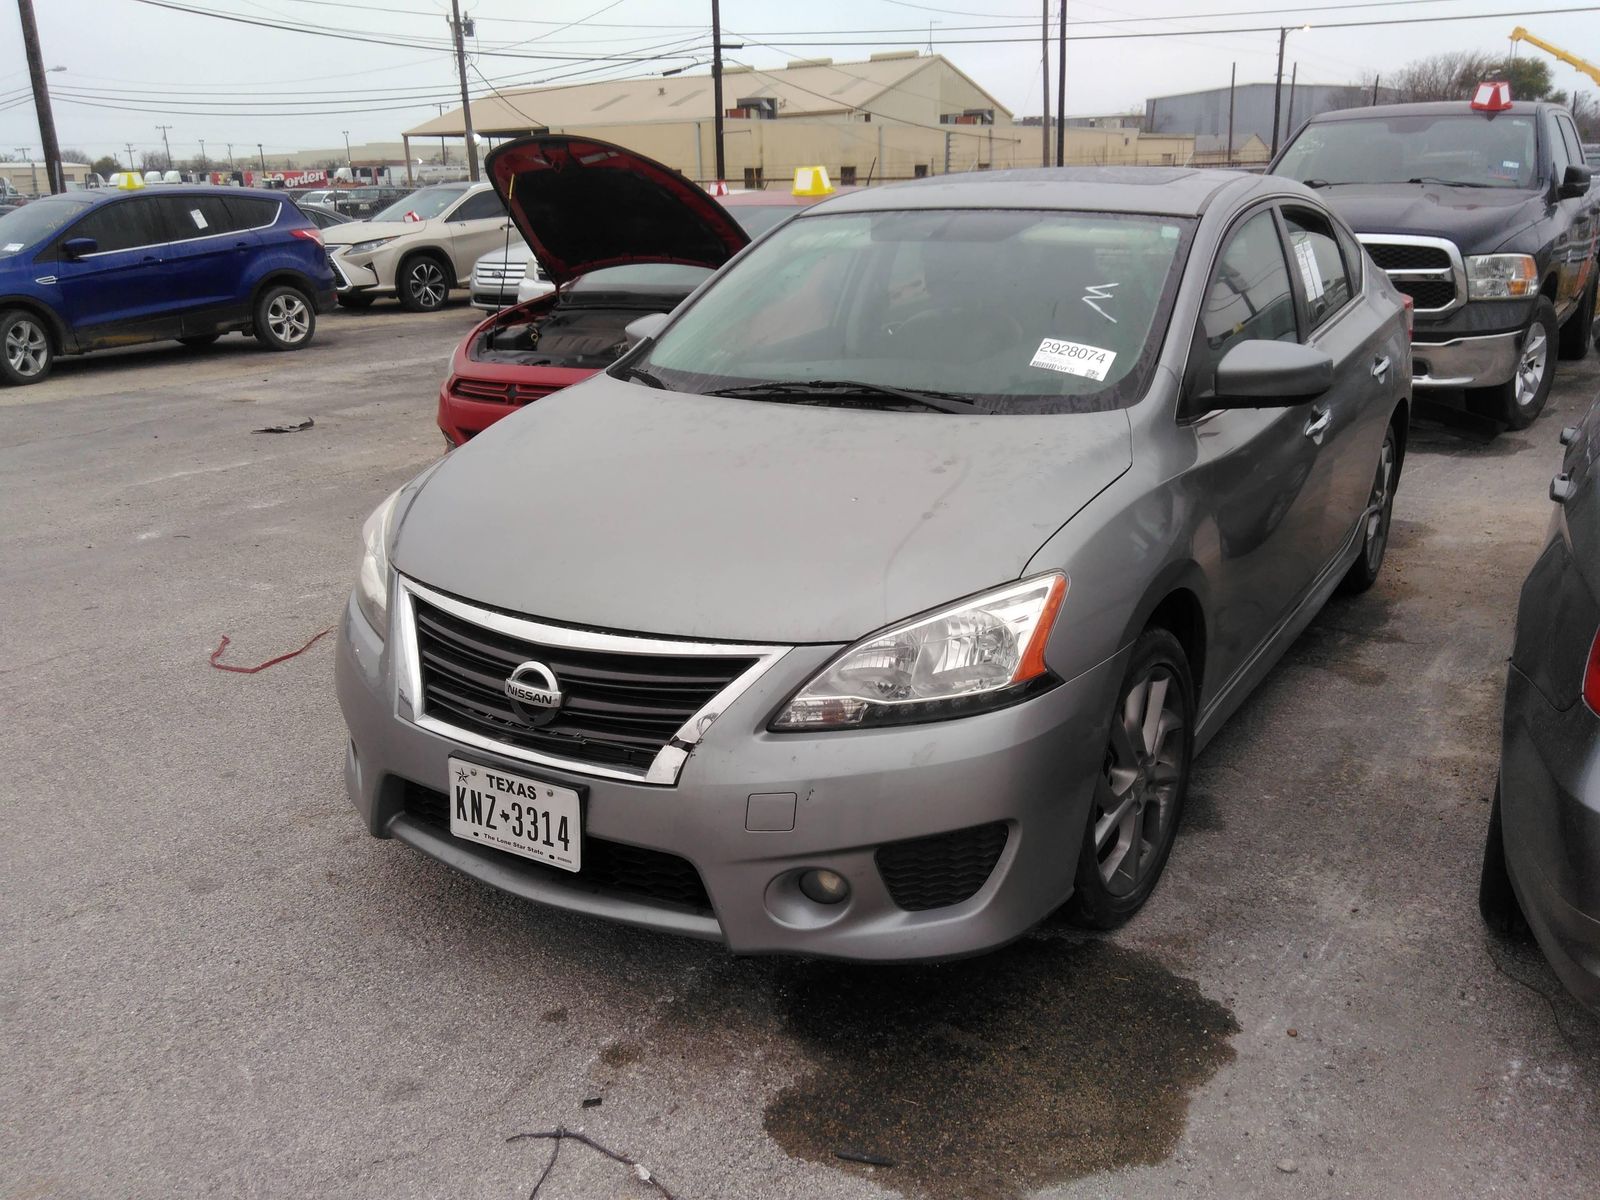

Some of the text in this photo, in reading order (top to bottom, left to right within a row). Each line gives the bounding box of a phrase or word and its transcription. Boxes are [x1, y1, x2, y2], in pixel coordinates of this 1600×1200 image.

[1040, 341, 1106, 364] 2928074
[507, 683, 552, 704] NISSAN
[486, 773, 537, 800] TEXAS
[484, 833, 544, 855] The Lone Star State
